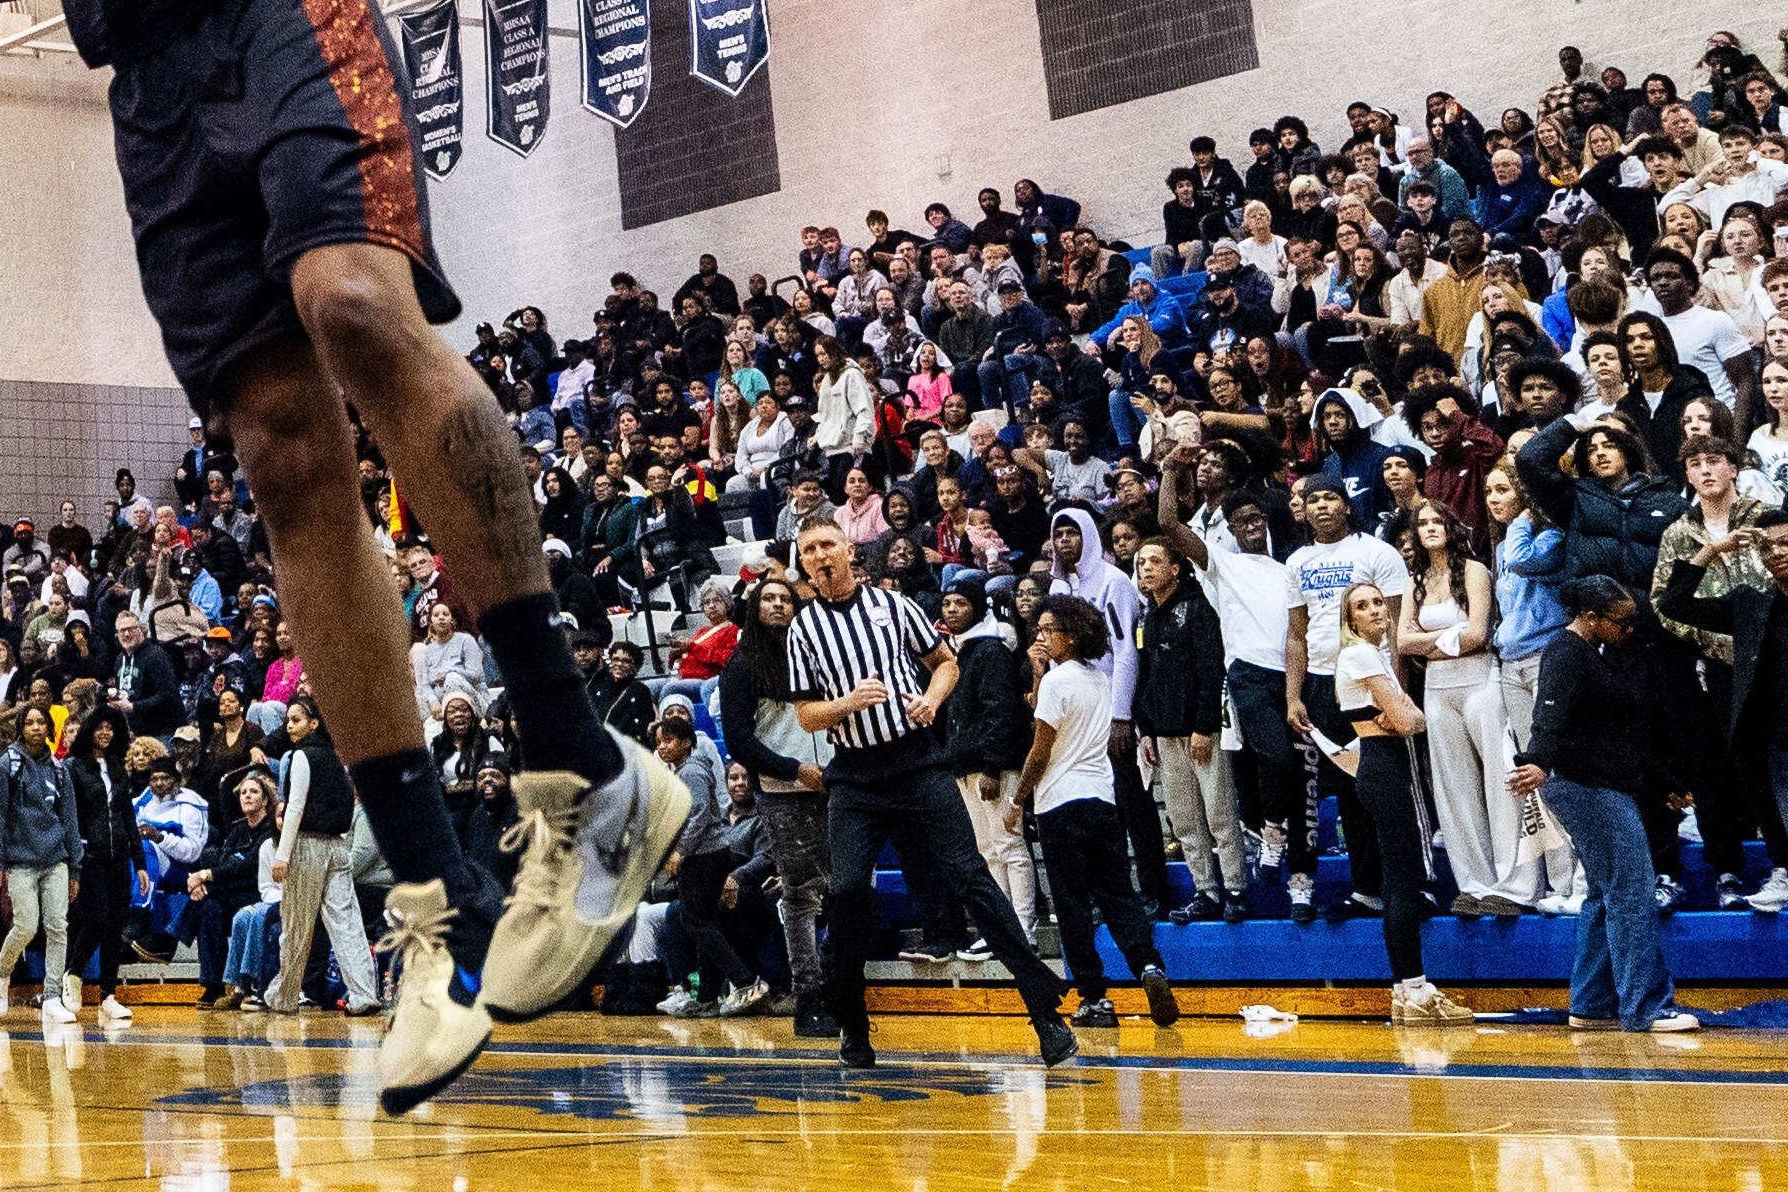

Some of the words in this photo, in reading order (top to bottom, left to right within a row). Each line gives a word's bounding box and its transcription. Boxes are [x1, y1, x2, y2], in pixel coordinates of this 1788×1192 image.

[594, 4, 639, 27] REGIONAL
[595, 15, 646, 39] CHAMPIONS
[1302, 570, 1351, 588] Knights
